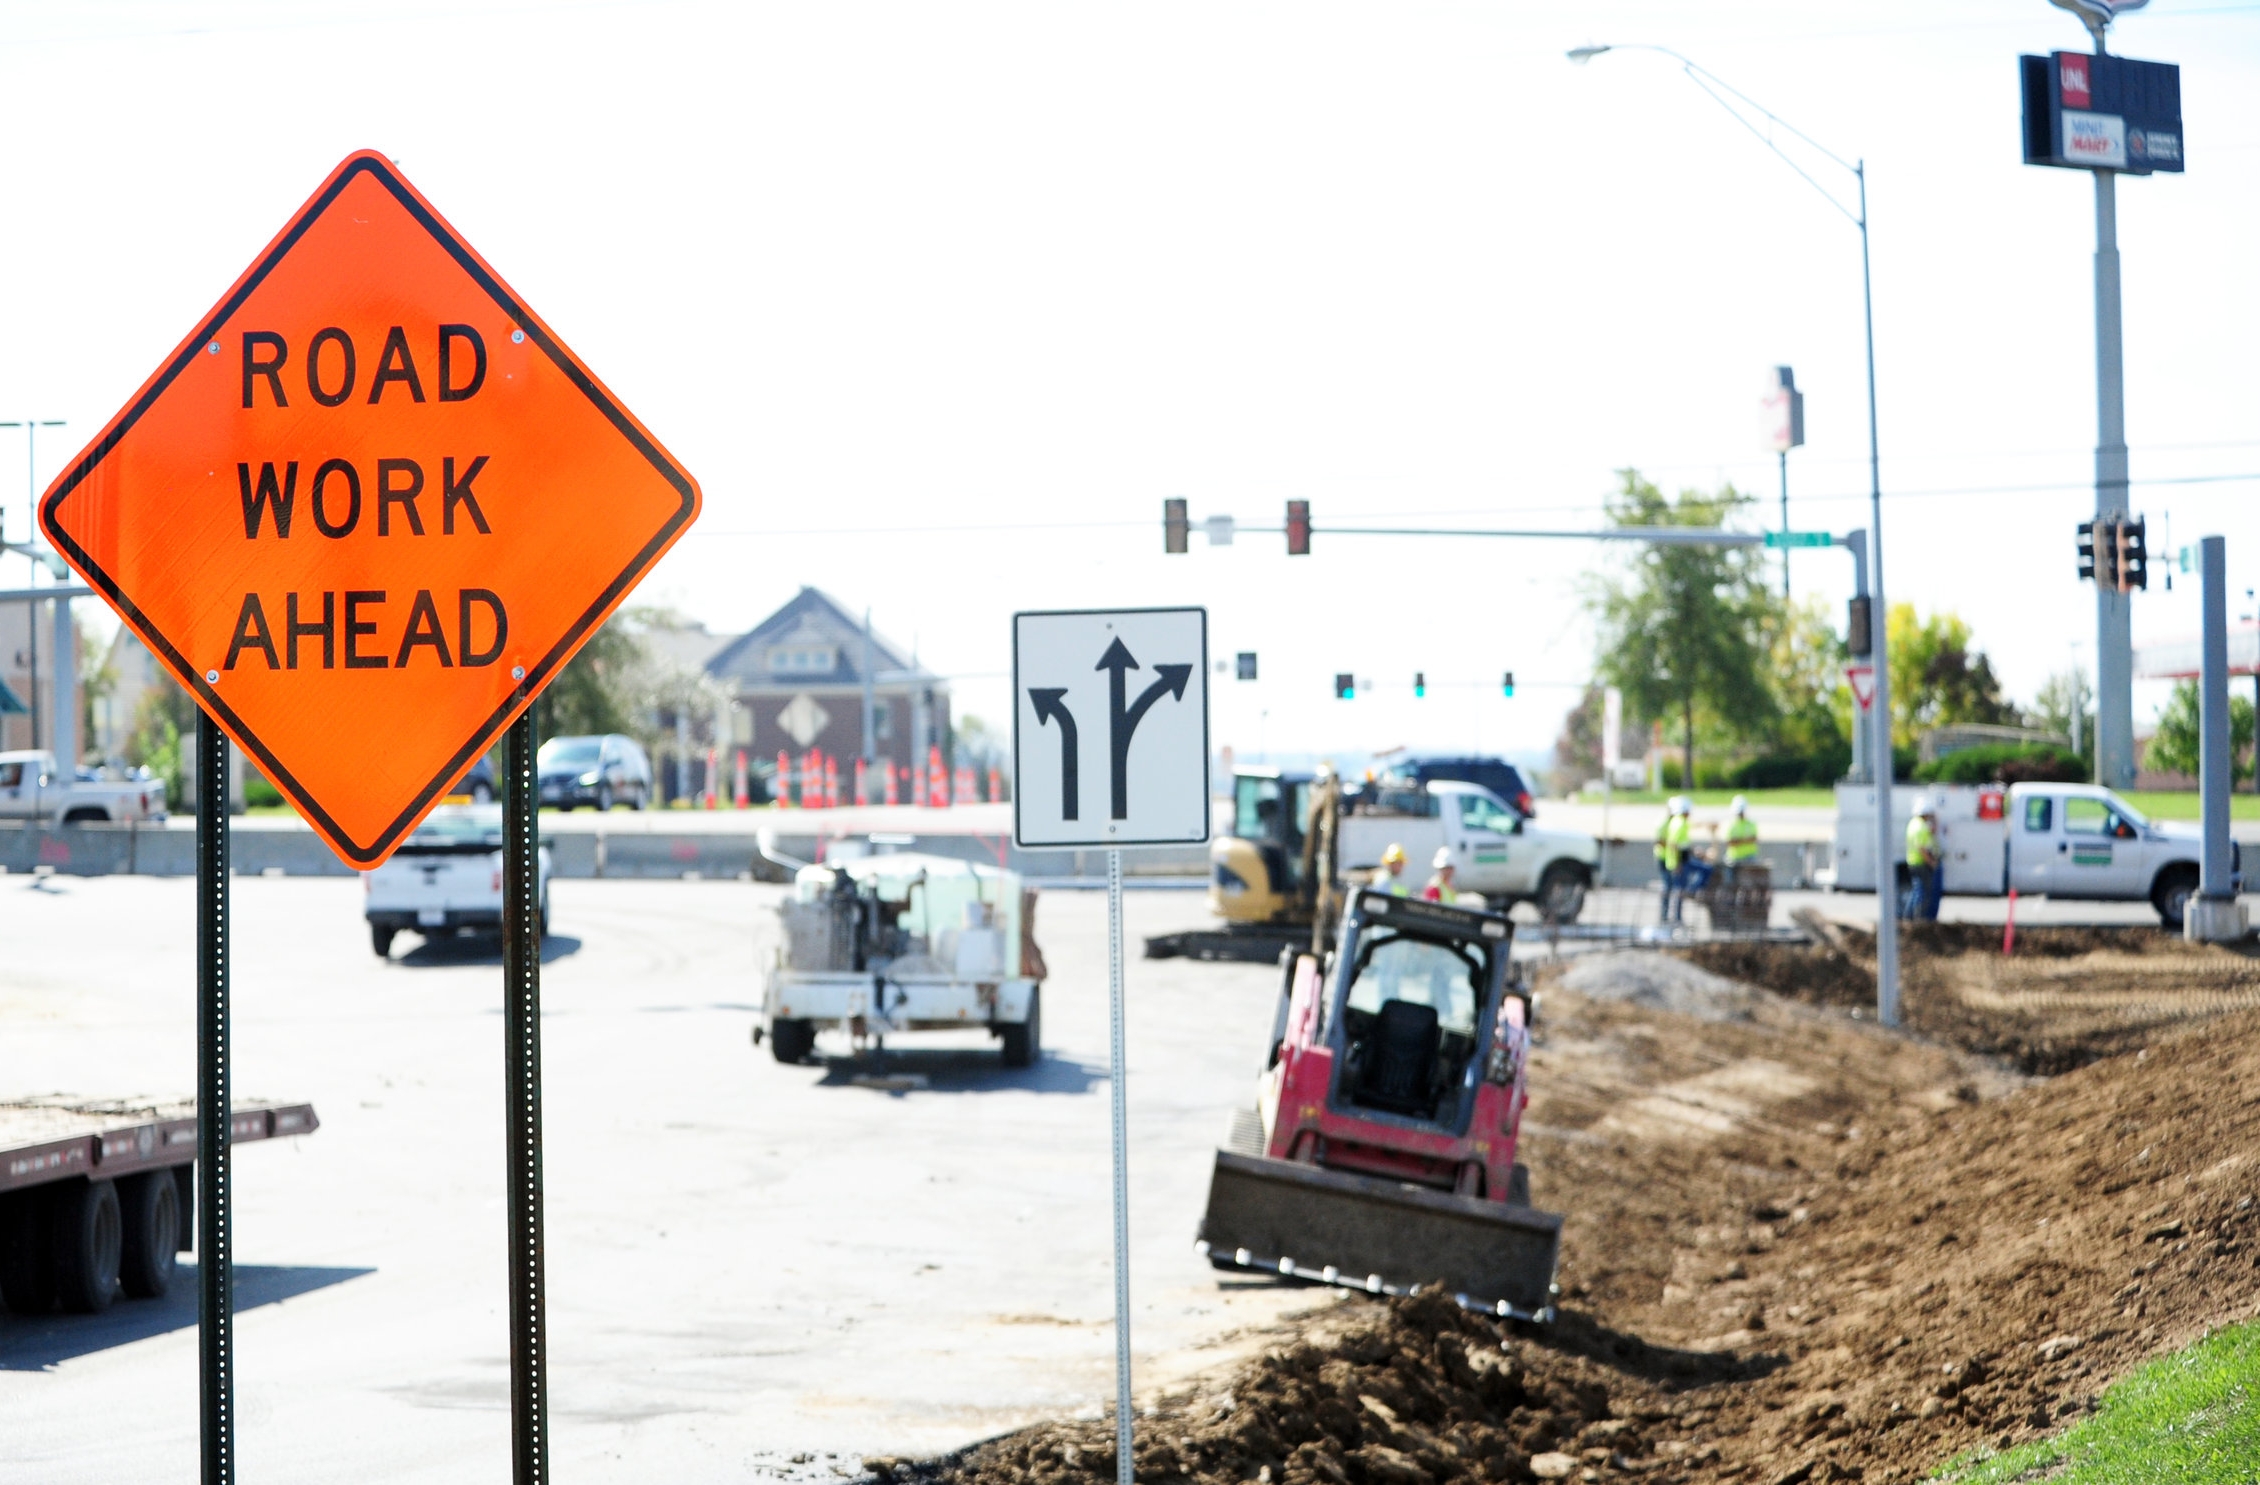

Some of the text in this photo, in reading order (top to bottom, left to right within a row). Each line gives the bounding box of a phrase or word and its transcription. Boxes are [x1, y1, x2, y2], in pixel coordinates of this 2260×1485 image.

[2060, 66, 2089, 93] UNL
[242, 324, 488, 408] ROAD
[238, 456, 491, 540] WORK
[224, 589, 508, 671] AHEAD
